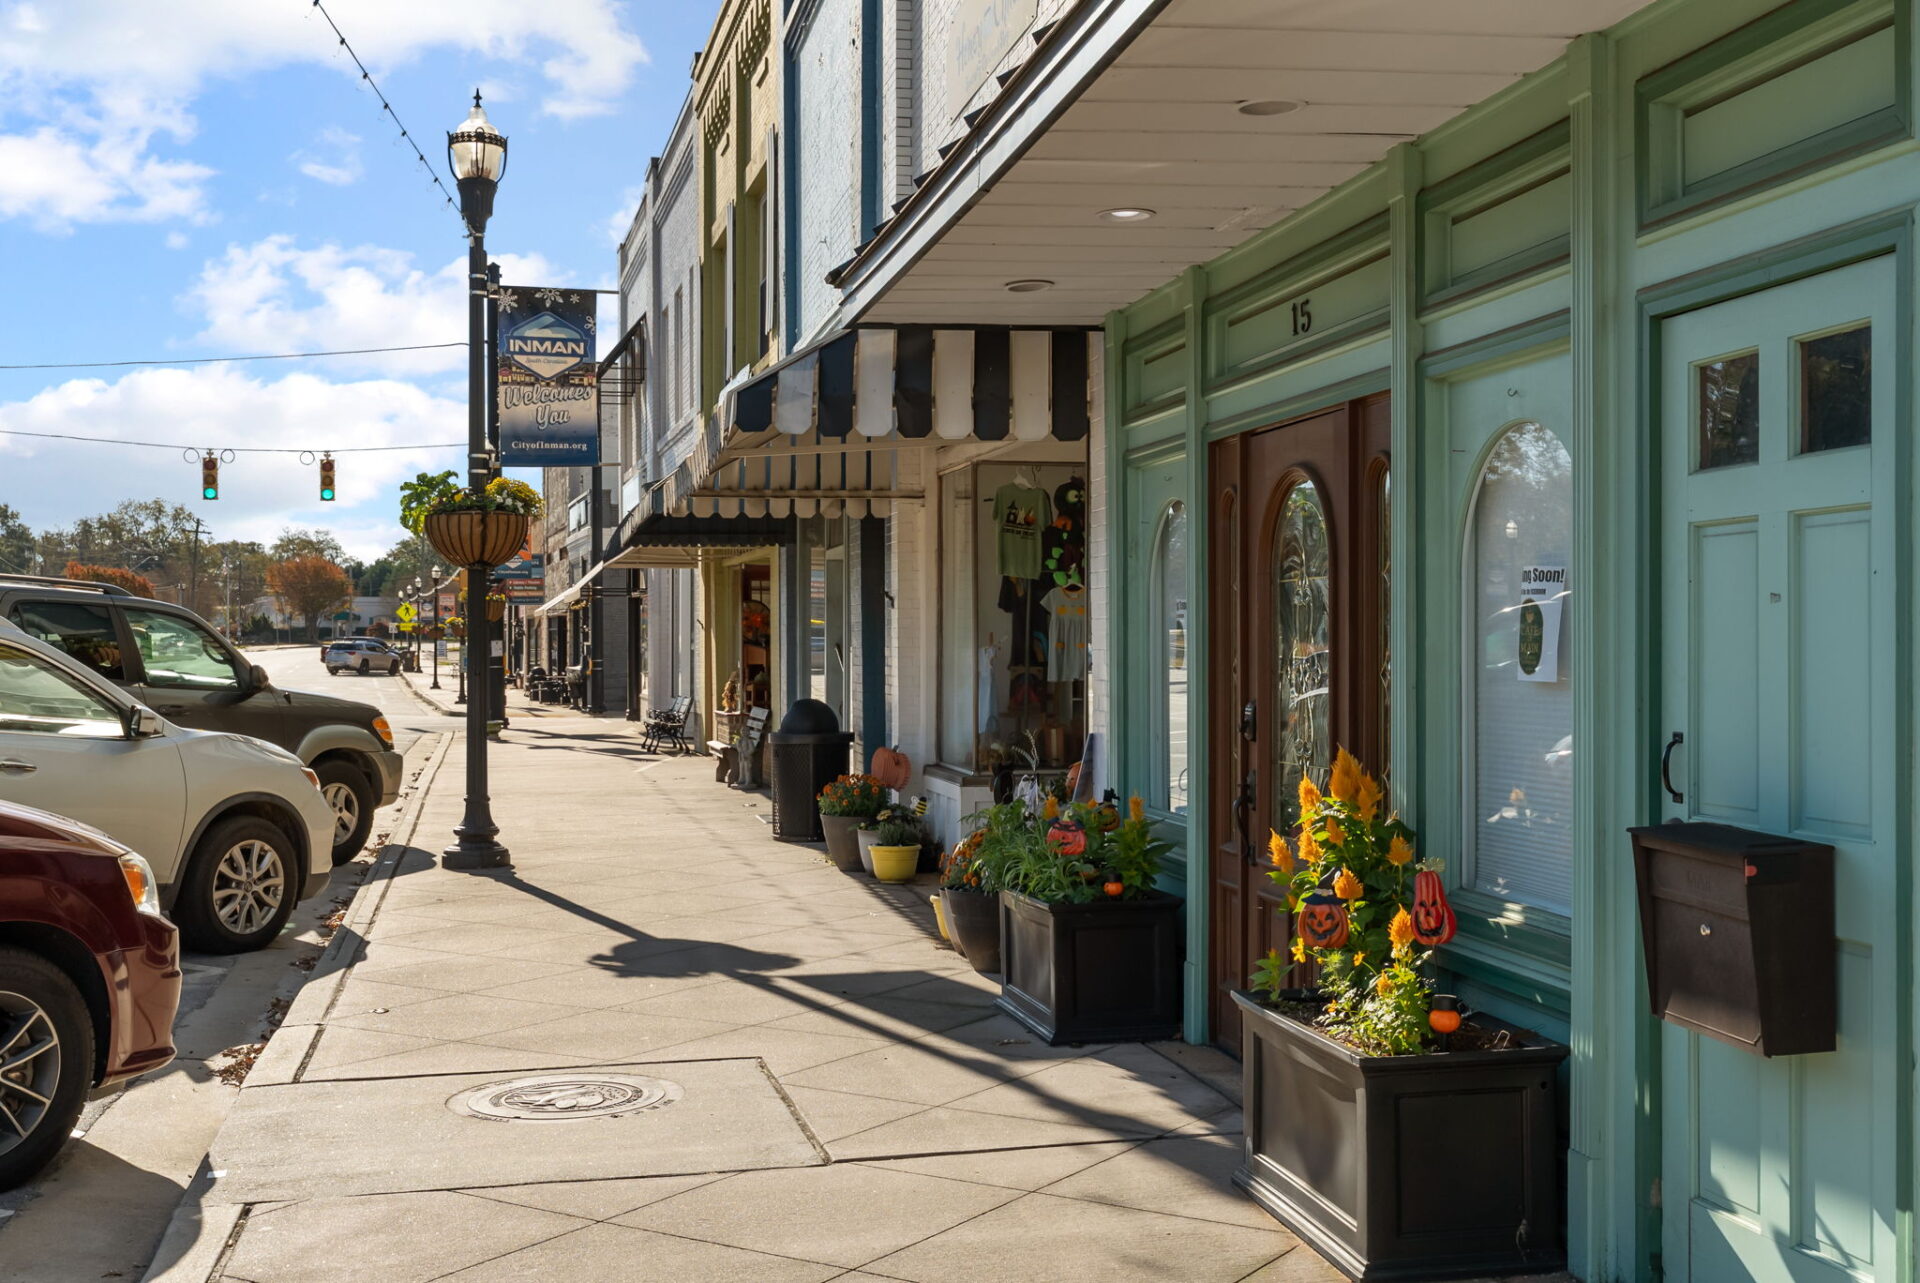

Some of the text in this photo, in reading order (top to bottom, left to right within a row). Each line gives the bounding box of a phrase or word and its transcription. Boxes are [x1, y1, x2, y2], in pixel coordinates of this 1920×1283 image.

[1292, 299, 1312, 336] 15
[509, 338, 585, 355] INMAN
[504, 384, 593, 409] Welcomes
[535, 405, 571, 430] You
[511, 441, 587, 451] CityofInman.org
[1533, 568, 1565, 583] Soon!
